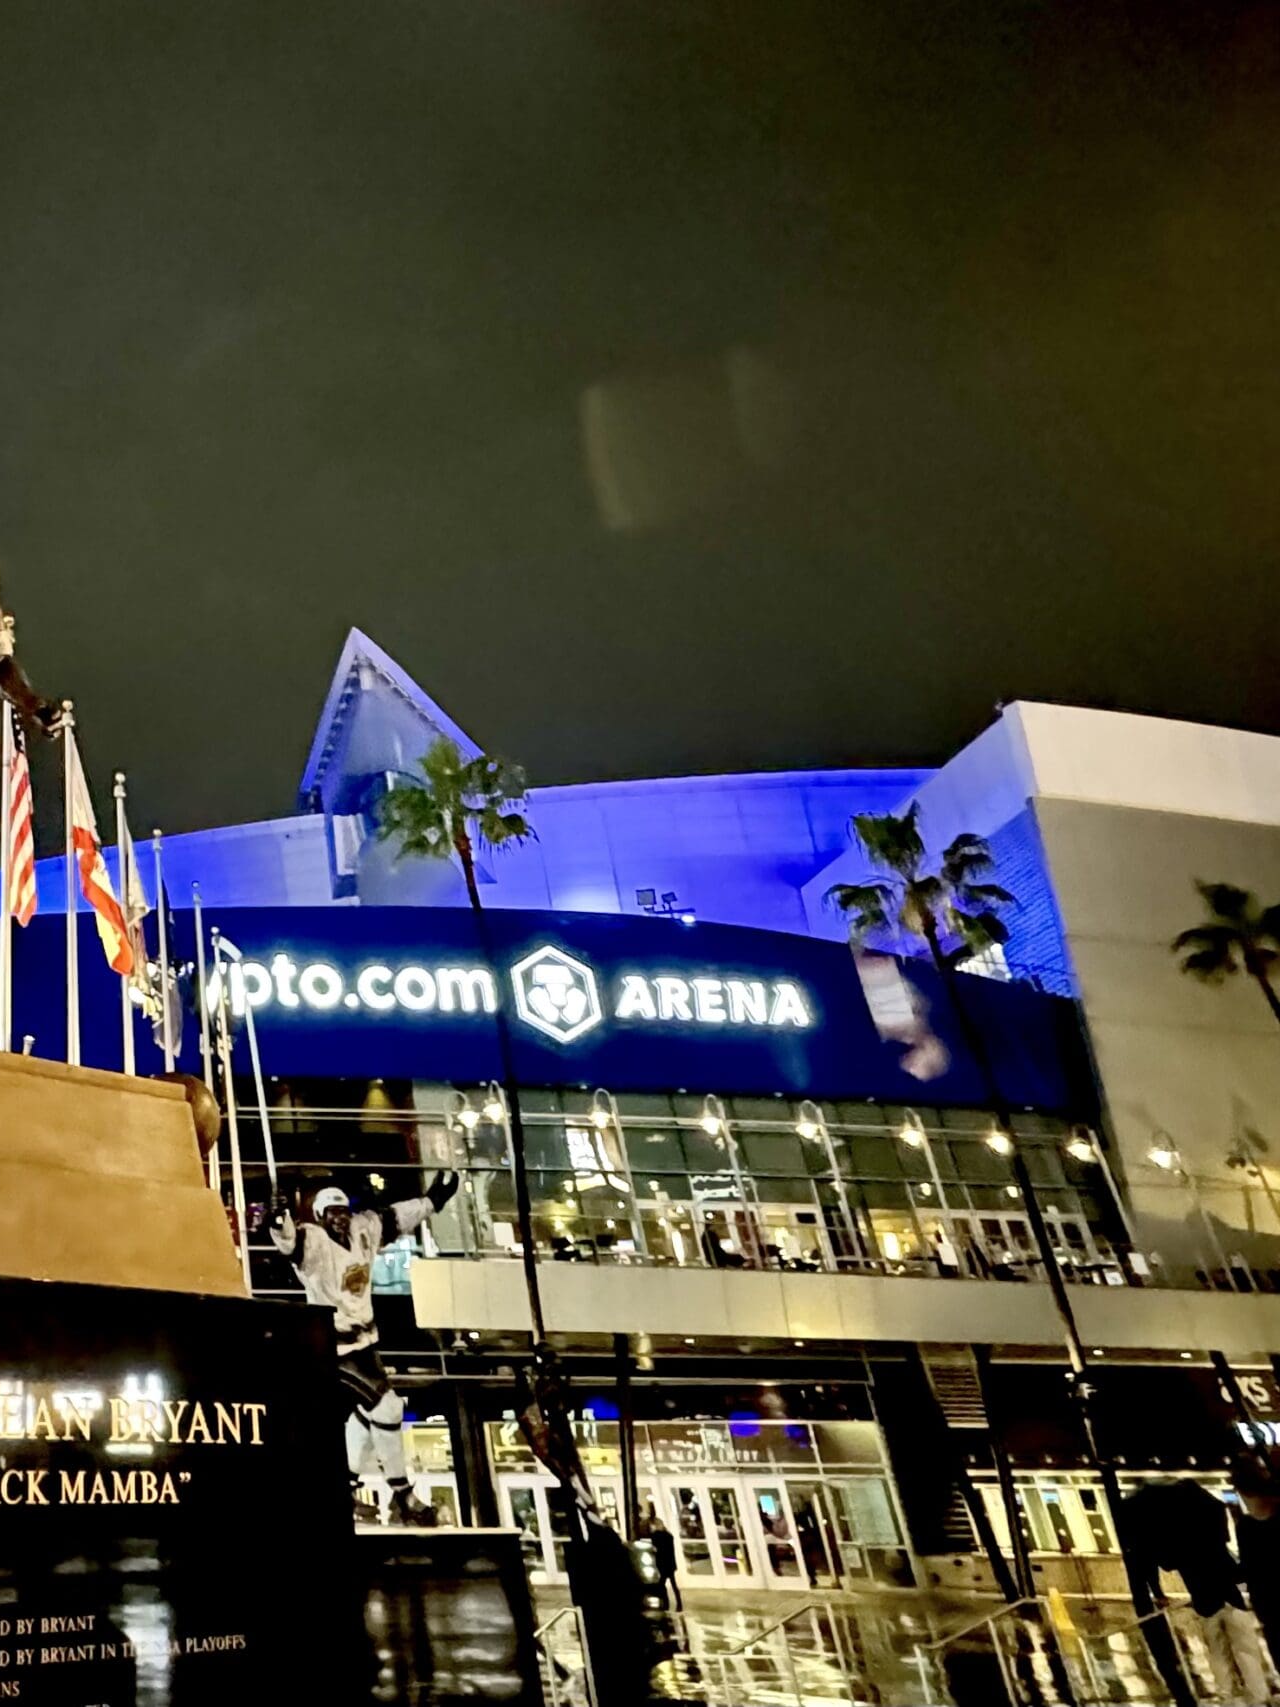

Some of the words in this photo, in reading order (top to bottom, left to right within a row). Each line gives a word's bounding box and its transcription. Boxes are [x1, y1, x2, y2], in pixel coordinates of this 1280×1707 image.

[614, 974, 811, 1027] ARENA
[109, 1397, 267, 1444] BRYANT
[17, 1618, 35, 1635] BY
[41, 1615, 95, 1633] BRYANT
[17, 1649, 35, 1666] BY
[41, 1644, 95, 1664] BRYANT
[101, 1643, 116, 1660] IN
[185, 1634, 246, 1653] PLAYOFFS
